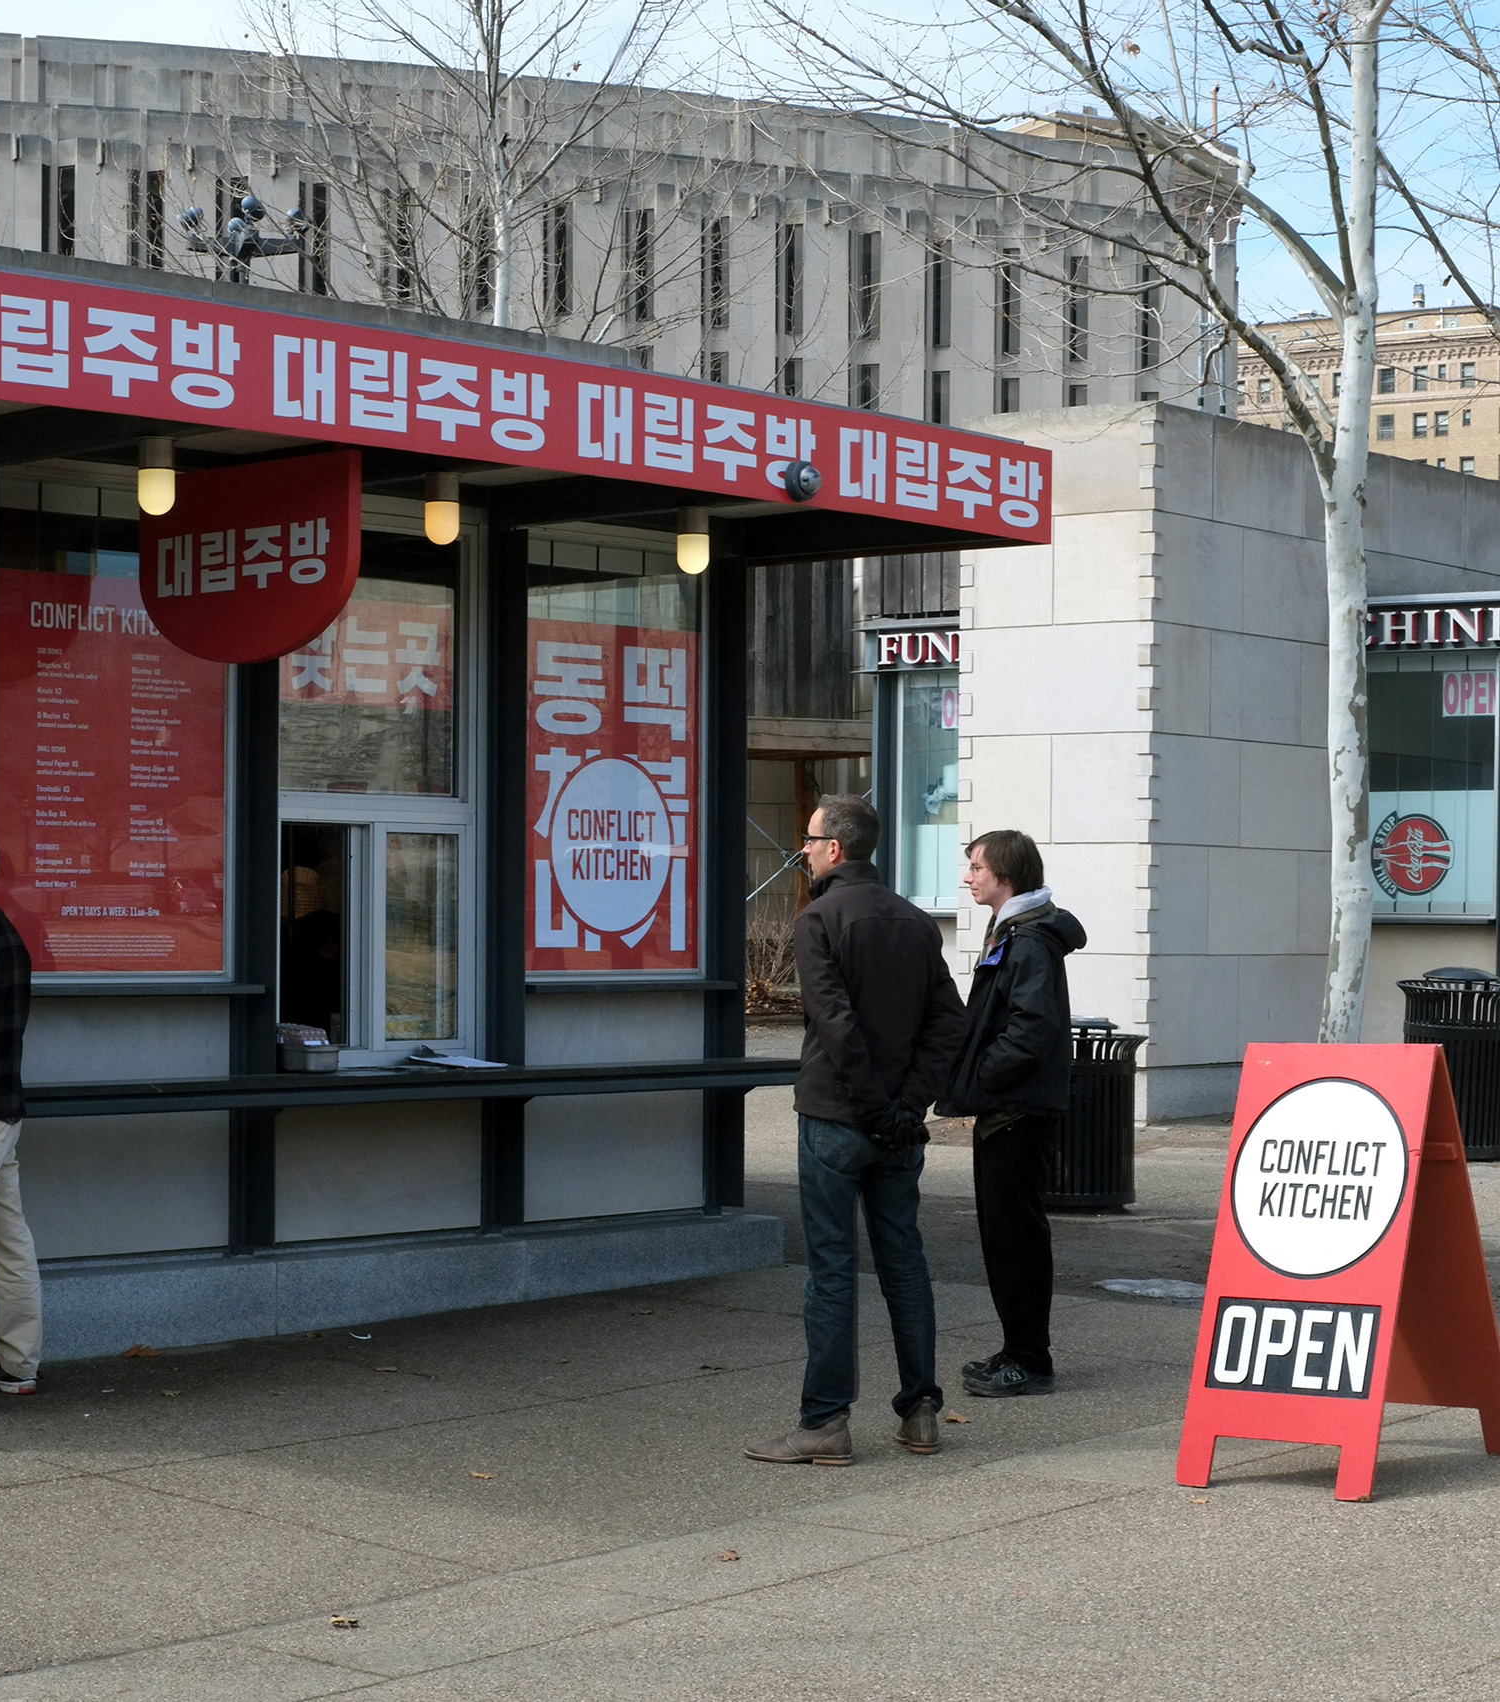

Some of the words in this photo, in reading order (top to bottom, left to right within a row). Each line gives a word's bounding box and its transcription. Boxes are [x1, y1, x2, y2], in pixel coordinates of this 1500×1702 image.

[273, 335, 550, 452] 대립주방
[578, 381, 816, 490] 대립주방
[838, 426, 1043, 529] 대립주방
[157, 517, 330, 598] 대립주방
[30, 601, 116, 633] CONFLICT
[1366, 607, 1500, 645] HIN
[878, 631, 960, 665] FUN
[63, 662, 71, 670] $2
[54, 687, 62, 696] $2
[62, 712, 70, 720] $2
[59, 810, 67, 818] $4
[567, 808, 657, 843] CONFLICT
[1375, 816, 1396, 845] STOP
[65, 857, 73, 865] $2
[129, 861, 138, 869] Ask
[145, 861, 159, 869] about
[572, 848, 652, 882] KITCHEN
[1406, 825, 1423, 884] Coca-Cola
[35, 879, 54, 888] Bottled
[54, 879, 70, 888] Water
[129, 870, 145, 878] weekly
[1374, 863, 1397, 895] CHILL
[61, 906, 78, 916] OPEN
[78, 906, 84, 916] 7
[84, 906, 102, 917] DAYS
[102, 906, 108, 916] A
[1259, 1139, 1387, 1177] CONFLICT
[1258, 1182, 1374, 1221] KITCHEN
[1213, 1304, 1375, 1393] OPEN
